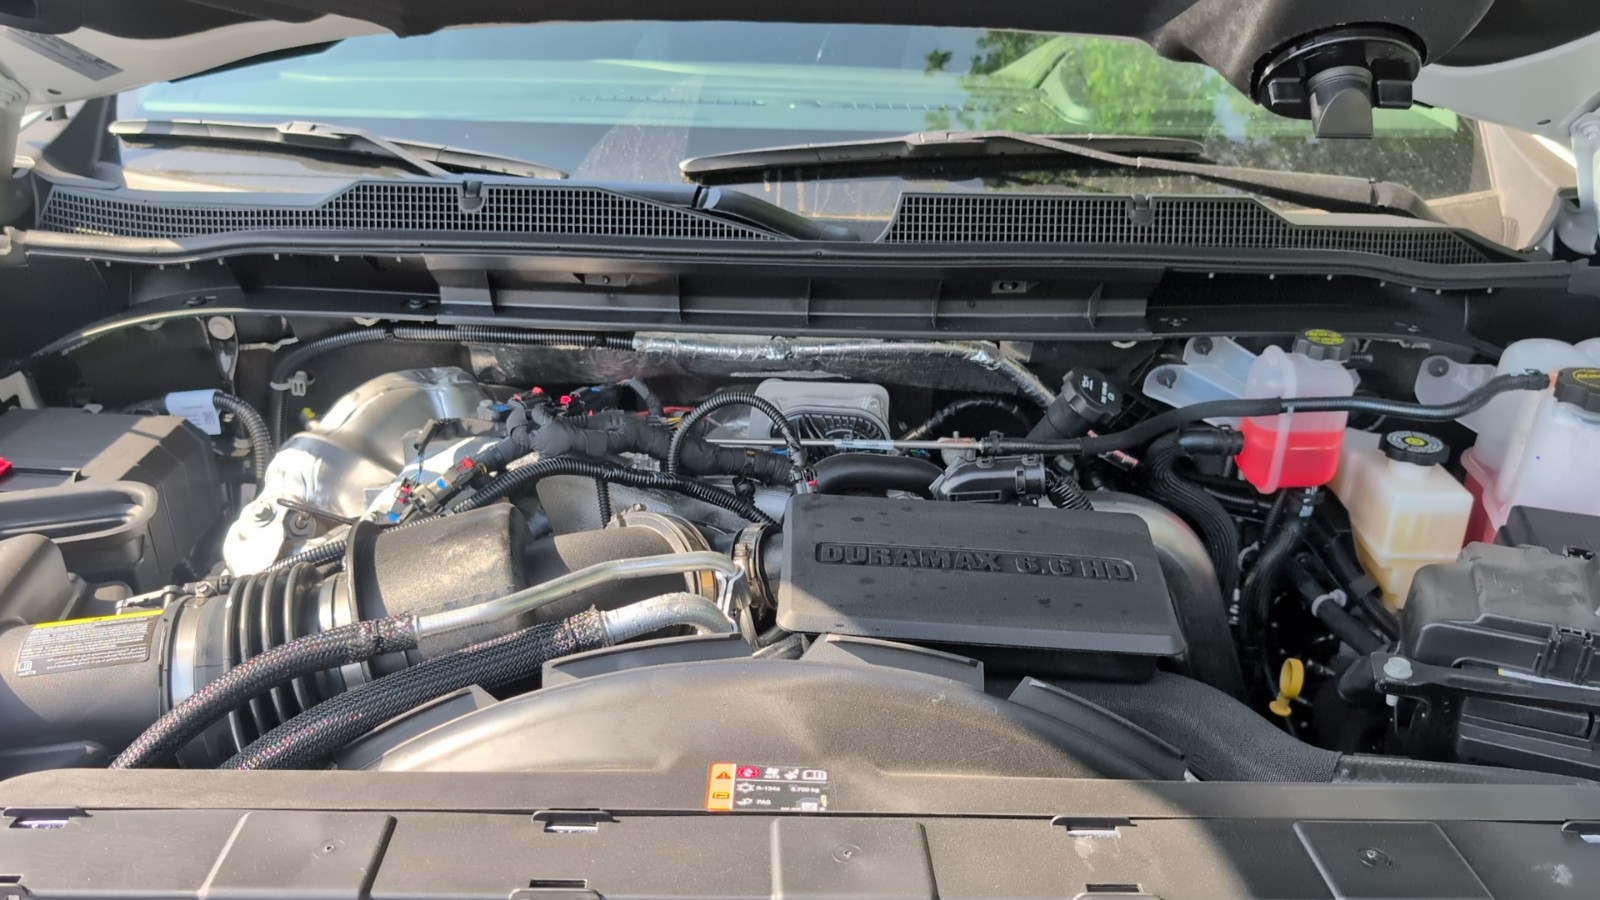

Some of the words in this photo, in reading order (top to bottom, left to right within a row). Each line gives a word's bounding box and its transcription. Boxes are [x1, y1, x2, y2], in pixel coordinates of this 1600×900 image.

[819, 544, 1000, 573] DURAMAX
[1014, 556, 1073, 576] 6.6
[1080, 559, 1131, 580] HD
